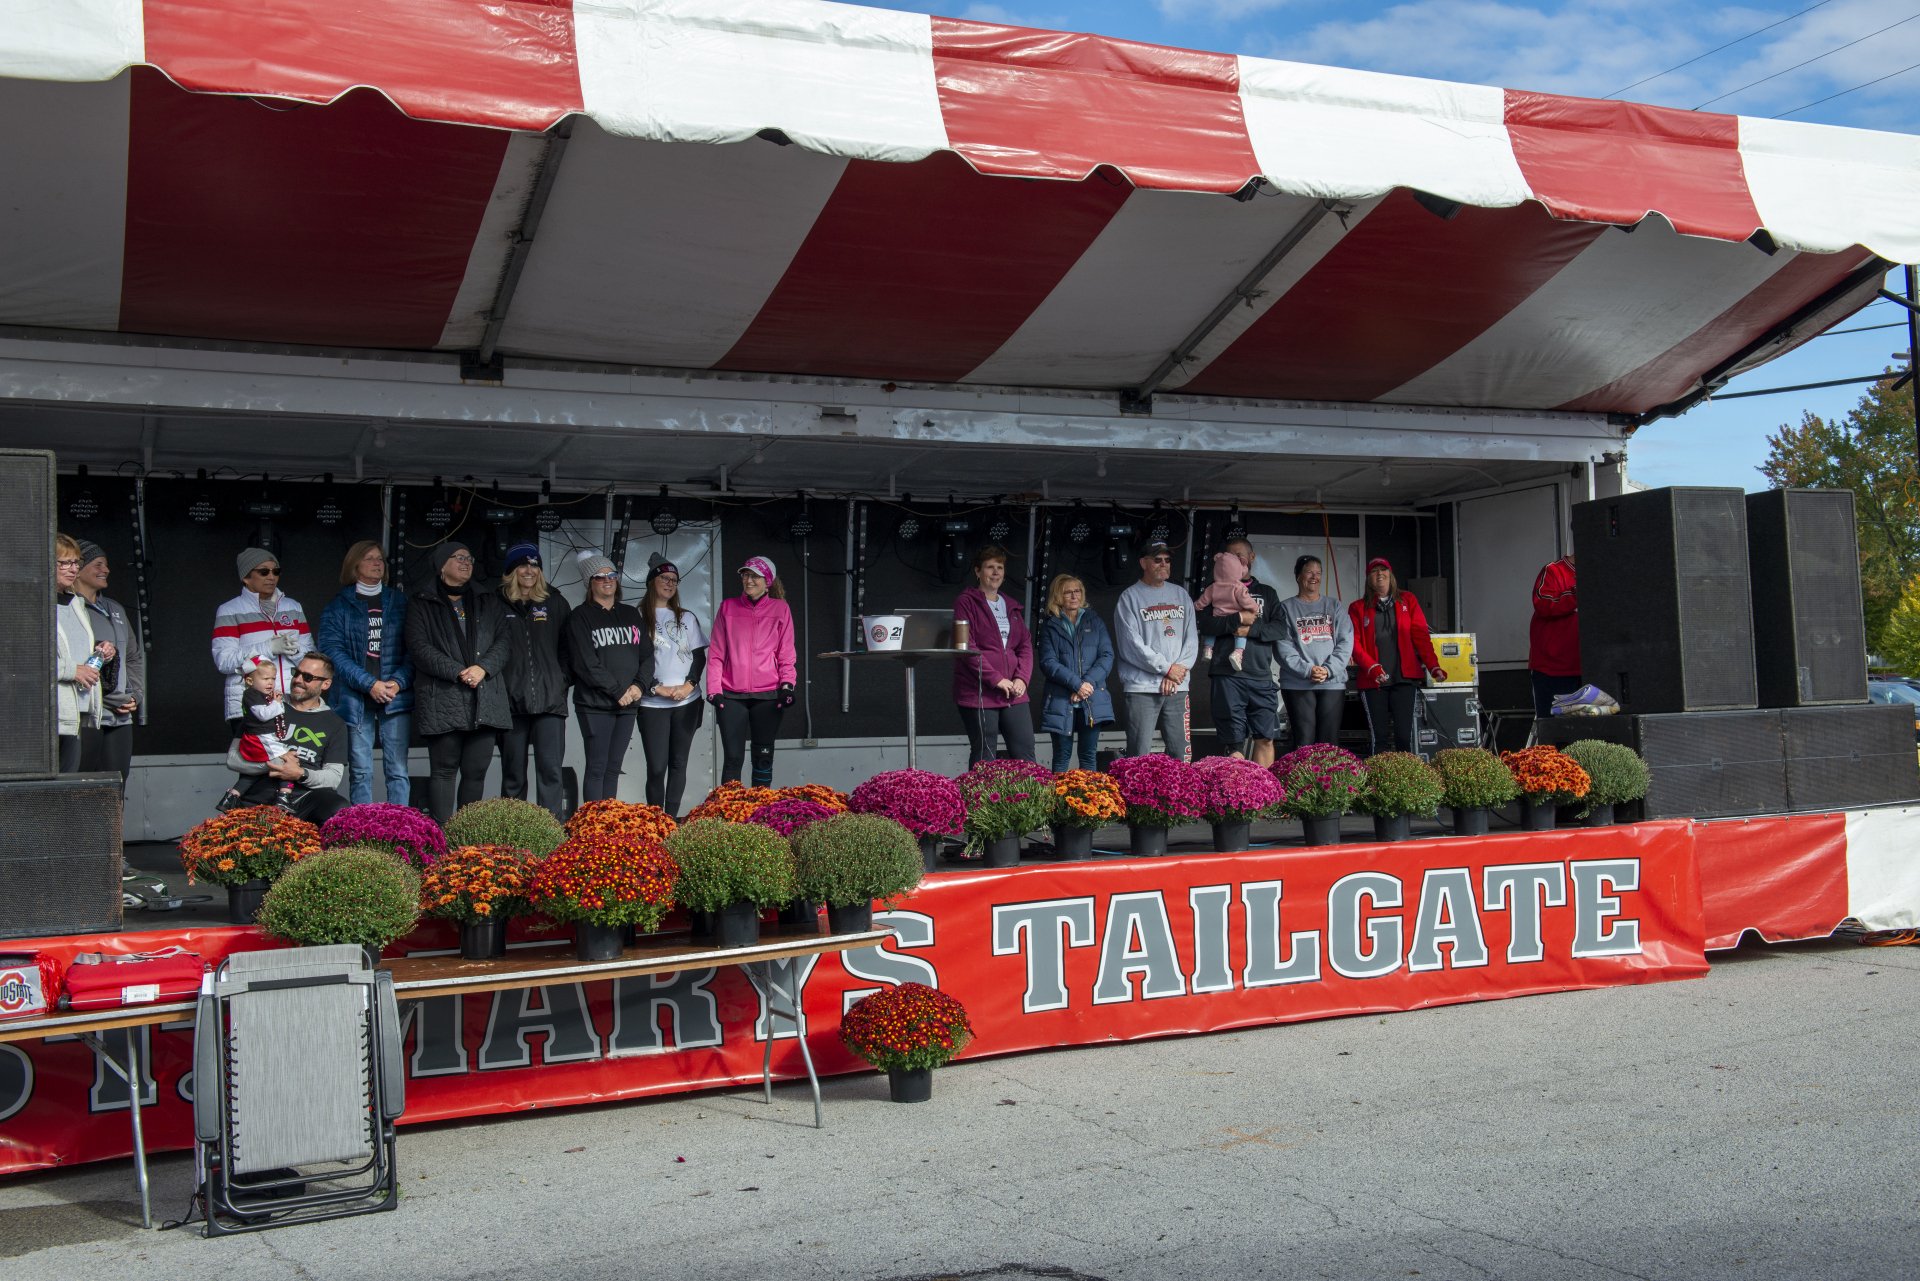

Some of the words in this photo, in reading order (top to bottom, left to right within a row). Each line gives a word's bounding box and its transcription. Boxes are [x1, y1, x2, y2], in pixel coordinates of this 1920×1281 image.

[1140, 605, 1185, 621] CHAMPIONS
[1296, 618, 1325, 627] STATE
[891, 626, 903, 637] 21
[990, 857, 1644, 1014] TAILGATE
